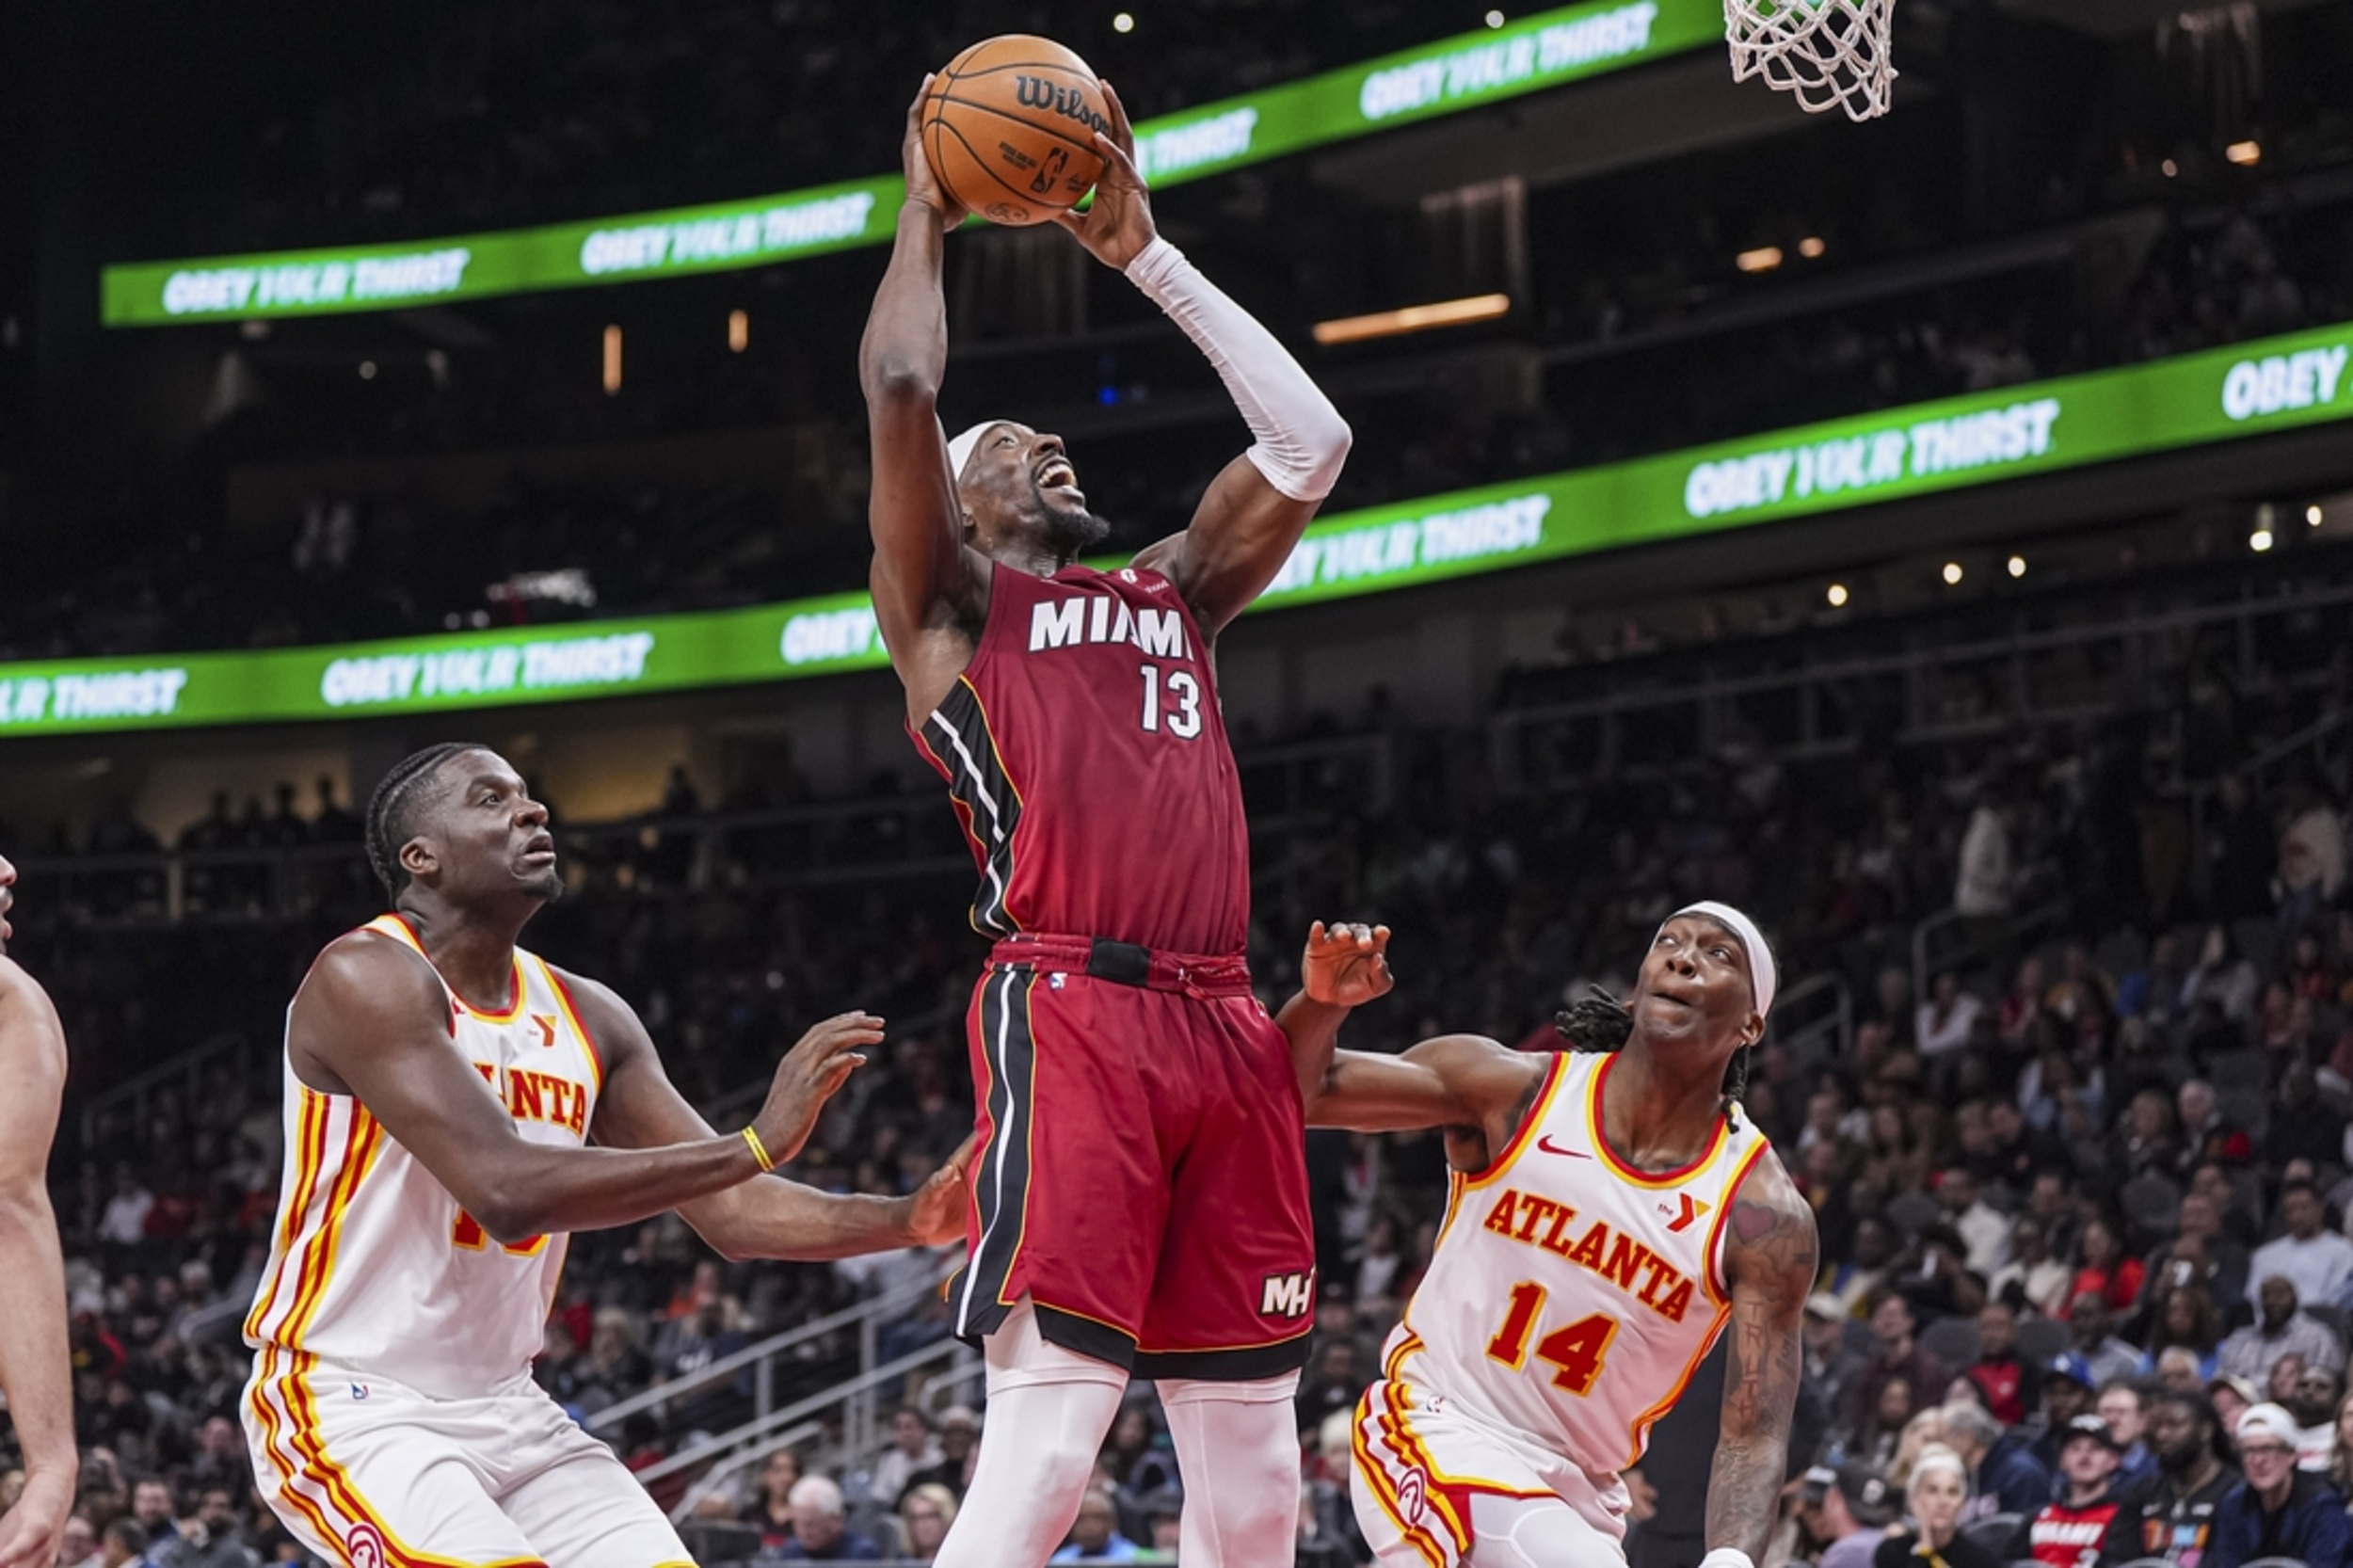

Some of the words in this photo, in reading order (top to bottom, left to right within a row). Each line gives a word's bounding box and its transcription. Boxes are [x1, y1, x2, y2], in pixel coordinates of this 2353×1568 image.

[1361, 56, 1449, 119] OBEY
[1536, 3, 1657, 72] THIRST
[582, 225, 672, 274] OBEY
[762, 192, 873, 248] THIRST
[164, 268, 257, 313] OBEY
[353, 248, 470, 298] THIRST
[2223, 345, 2347, 419] OBEY
[1686, 450, 1796, 517] OBEY
[1909, 399, 2059, 475] THIRST
[1420, 494, 1550, 565] THIRST
[322, 654, 423, 706] OBEY
[520, 632, 653, 688] THIRST
[781, 604, 875, 664] OBEY
[53, 669, 186, 719] THIRST
[1140, 664, 1203, 740] 13
[1483, 1188, 1695, 1324] ATLANTA
[1485, 1279, 1620, 1399] 14
